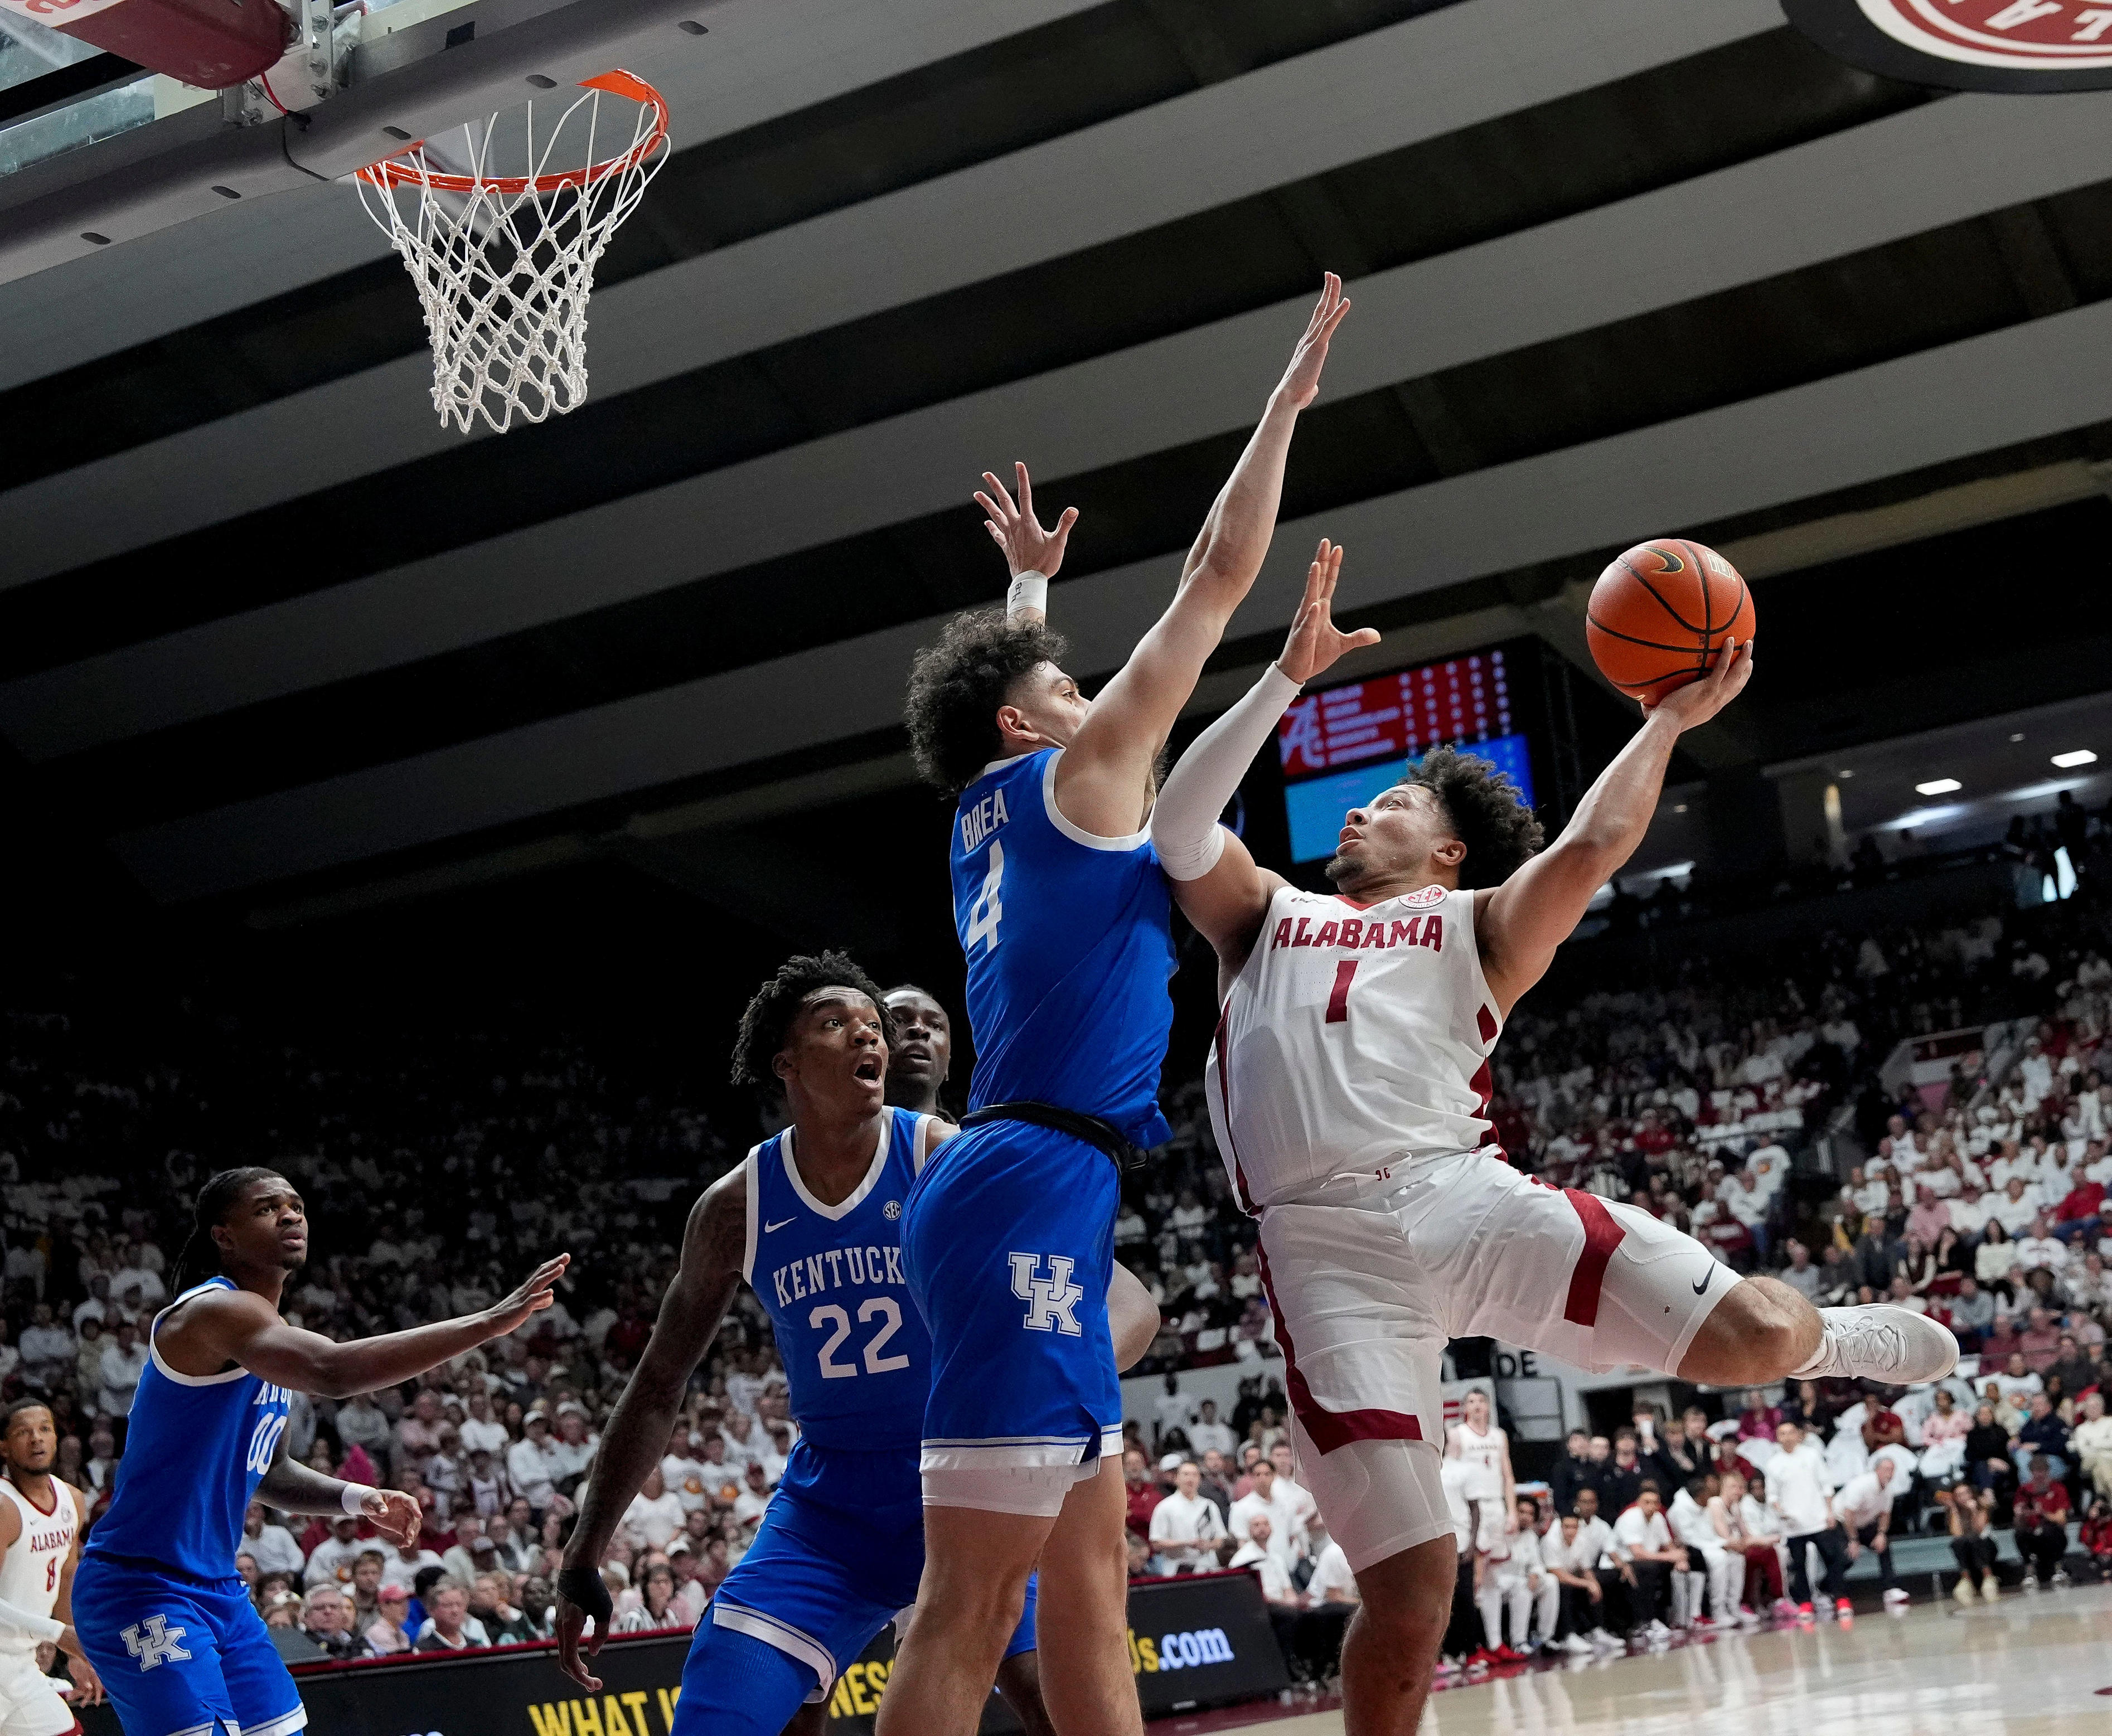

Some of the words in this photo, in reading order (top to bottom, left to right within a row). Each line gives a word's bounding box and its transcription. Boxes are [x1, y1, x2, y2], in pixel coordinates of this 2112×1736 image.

[961, 788, 1009, 854] BREA
[968, 838, 1004, 953] 4
[1408, 887, 1442, 903] SEC
[1271, 915, 1442, 953] ALABAMA
[1326, 960, 1359, 1024] 1
[884, 1201, 900, 1219] SEC
[773, 1246, 905, 1308] KENTUCK
[1008, 1251, 1084, 1337] UK
[808, 1296, 910, 1379] 22
[246, 1412, 288, 1476] 00
[46, 1556, 57, 1592] 8
[120, 1613, 192, 1672] UK
[527, 1690, 647, 1736] WHAT
